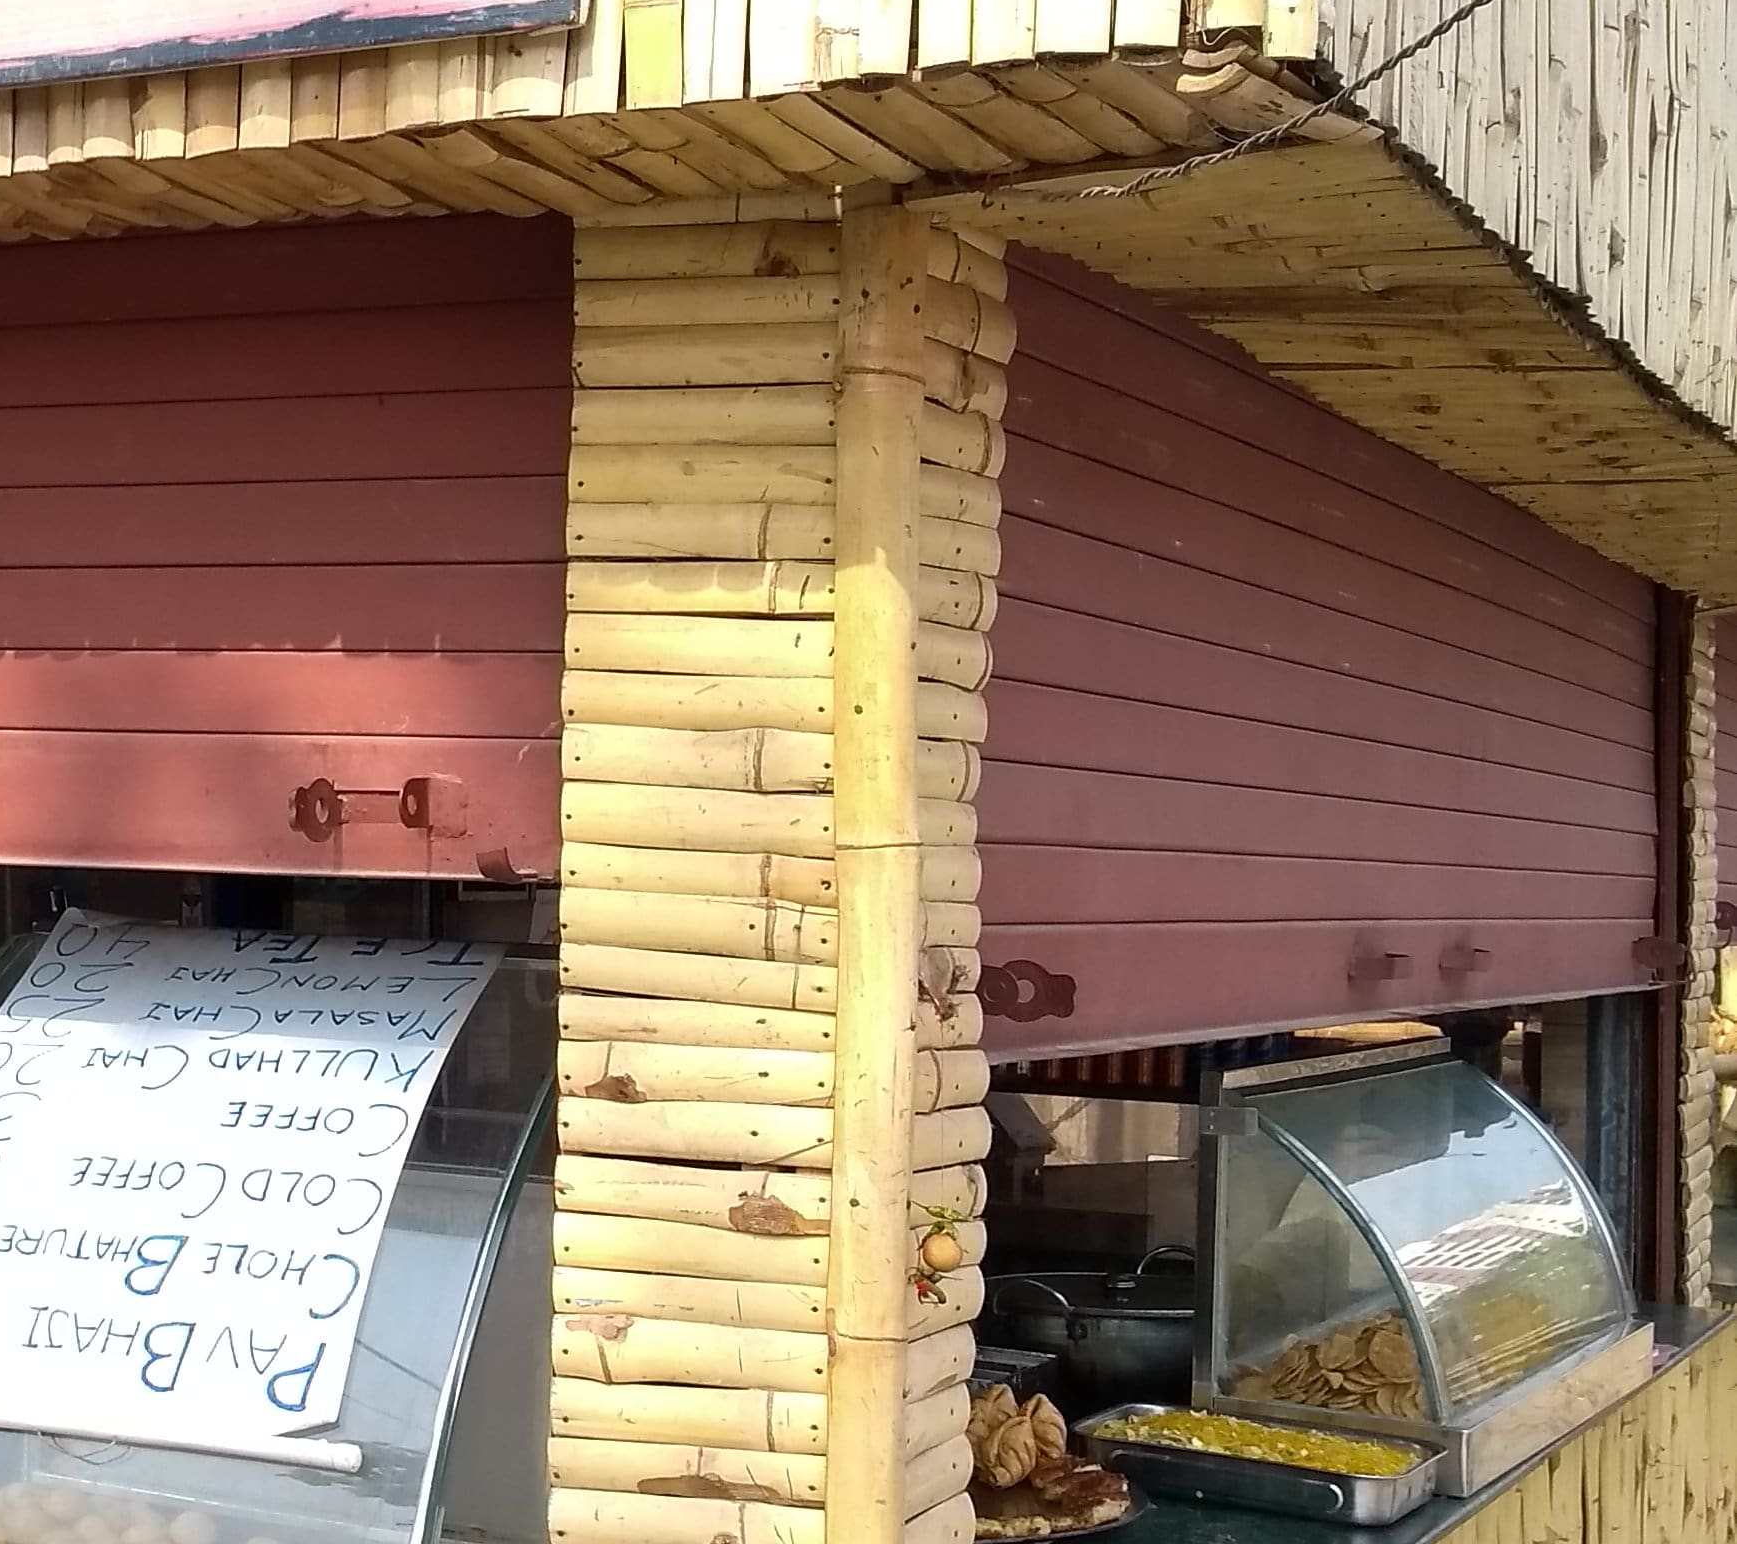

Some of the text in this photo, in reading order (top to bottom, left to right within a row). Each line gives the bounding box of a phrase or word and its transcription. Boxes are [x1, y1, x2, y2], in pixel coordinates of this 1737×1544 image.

[58, 925, 151, 957] 40
[231, 934, 320, 964] TEA
[31, 961, 133, 991] 20
[6, 995, 104, 1037] 25
[81, 1044, 190, 1089] CHAI
[208, 1048, 434, 1092] KULLHAD
[220, 1101, 408, 1157] COFFEE
[69, 1156, 226, 1219] COFFEE
[242, 1168, 382, 1235] COLD
[203, 1242, 360, 1318] CHOLE
[22, 1305, 195, 1392] BHAJI
[206, 1325, 325, 1413] PAV
